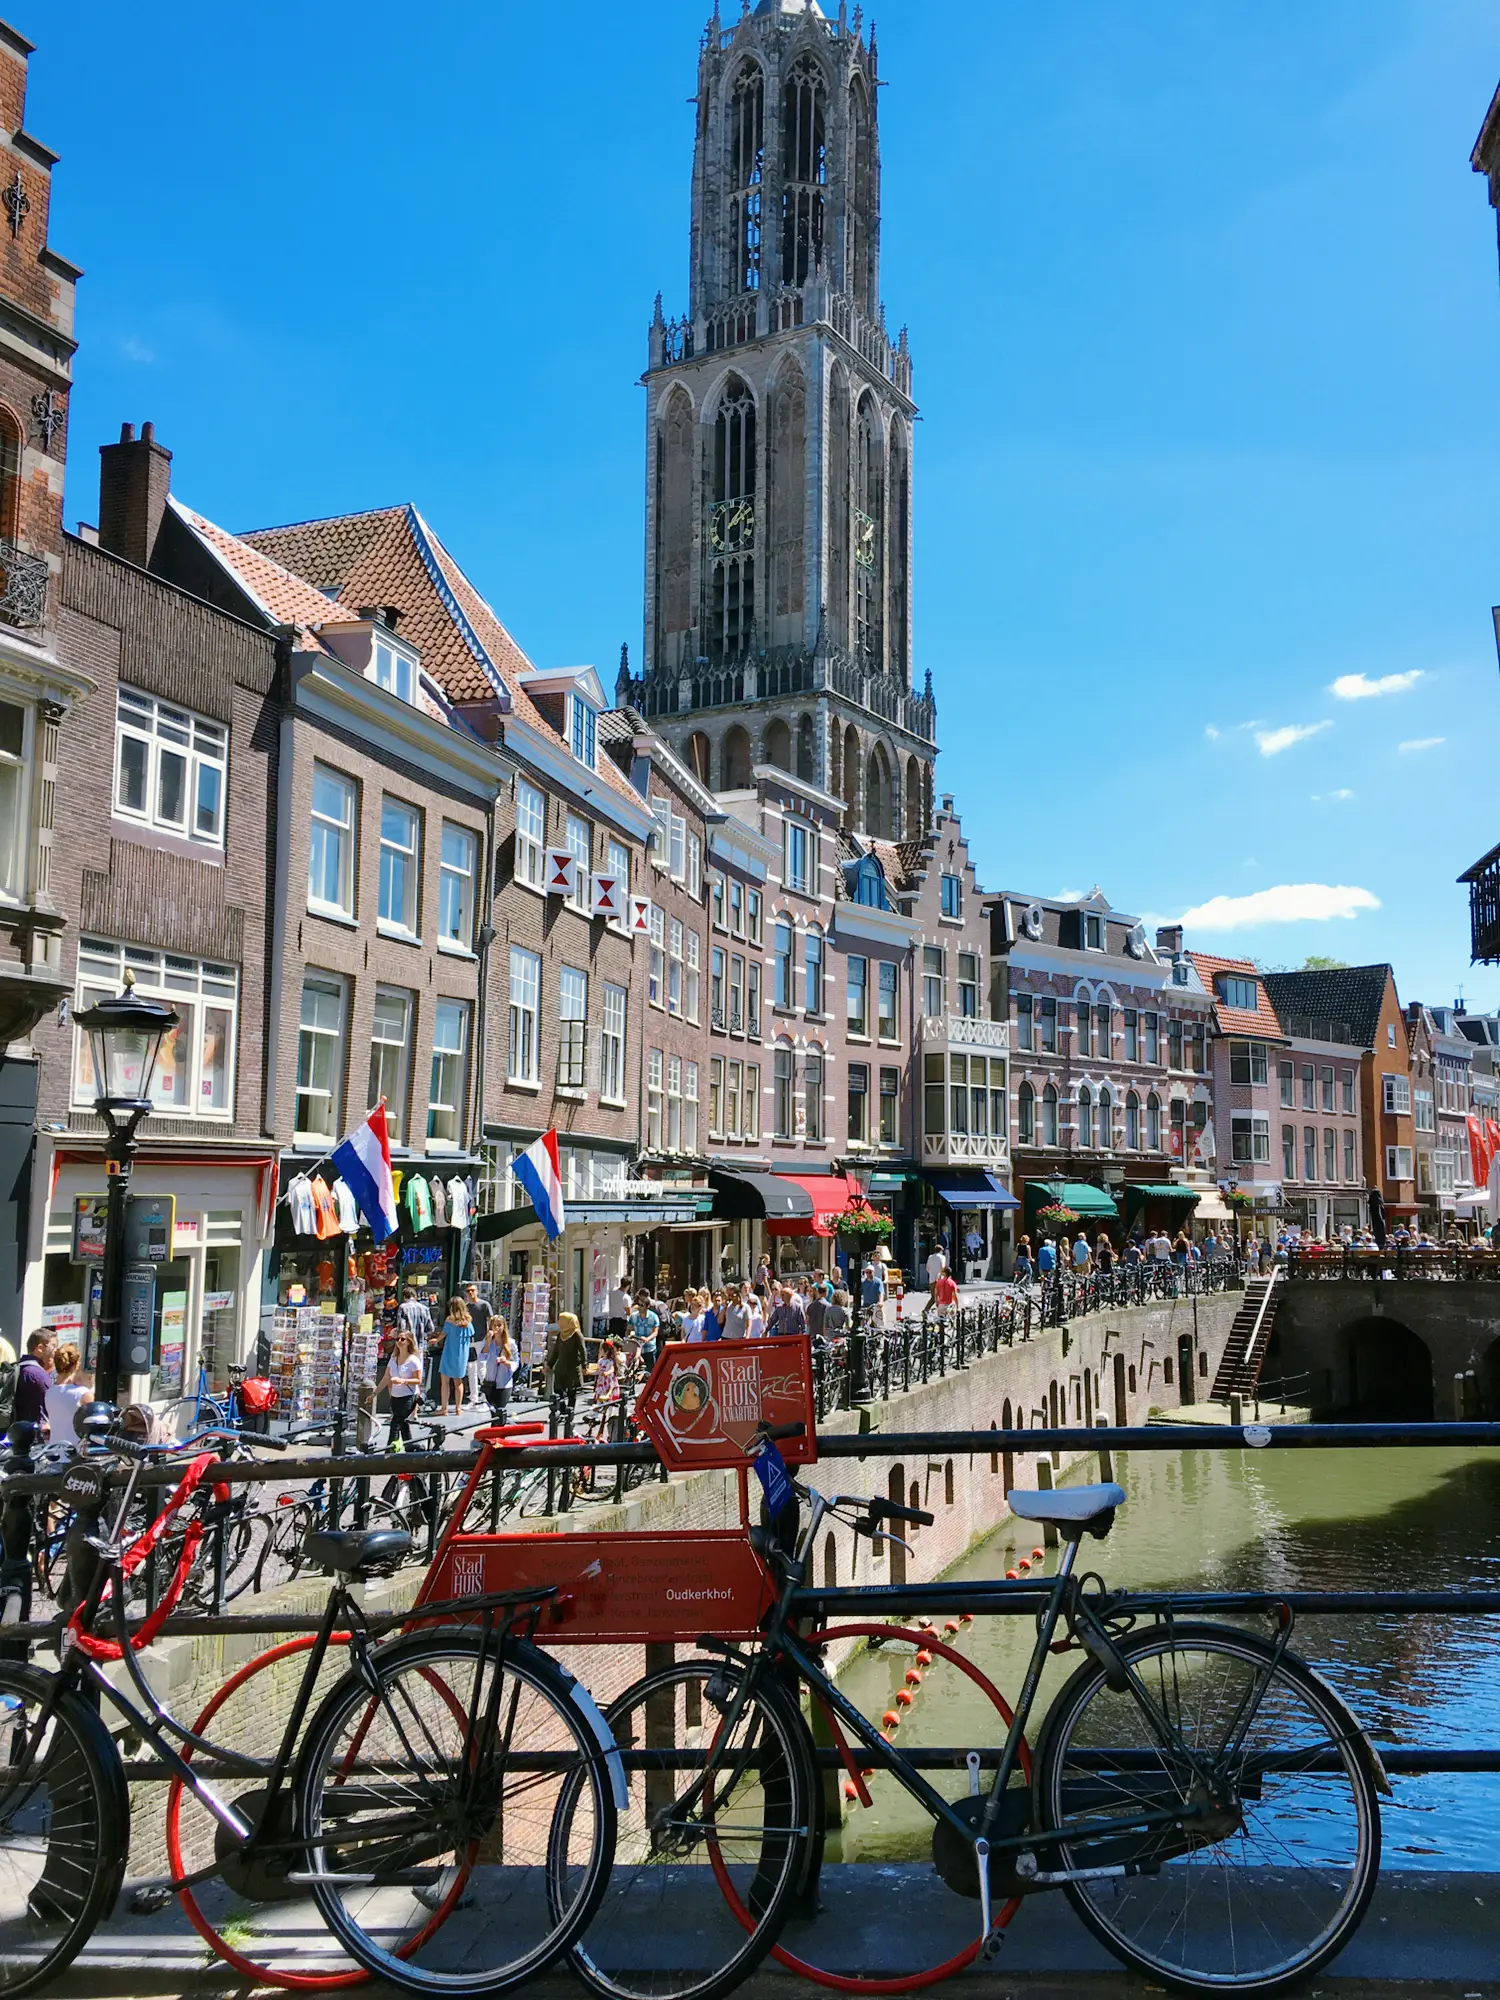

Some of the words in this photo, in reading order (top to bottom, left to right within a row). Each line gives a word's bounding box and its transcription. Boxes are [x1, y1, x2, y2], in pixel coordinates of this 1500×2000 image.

[720, 1356, 757, 1383] Stad
[722, 1382, 758, 1407] HUIS
[722, 1405, 759, 1423] KWARTIER
[454, 1554, 483, 1575] Stad
[454, 1574, 482, 1595] HUIS
[666, 1588, 735, 1600] Oudkerkhof,
